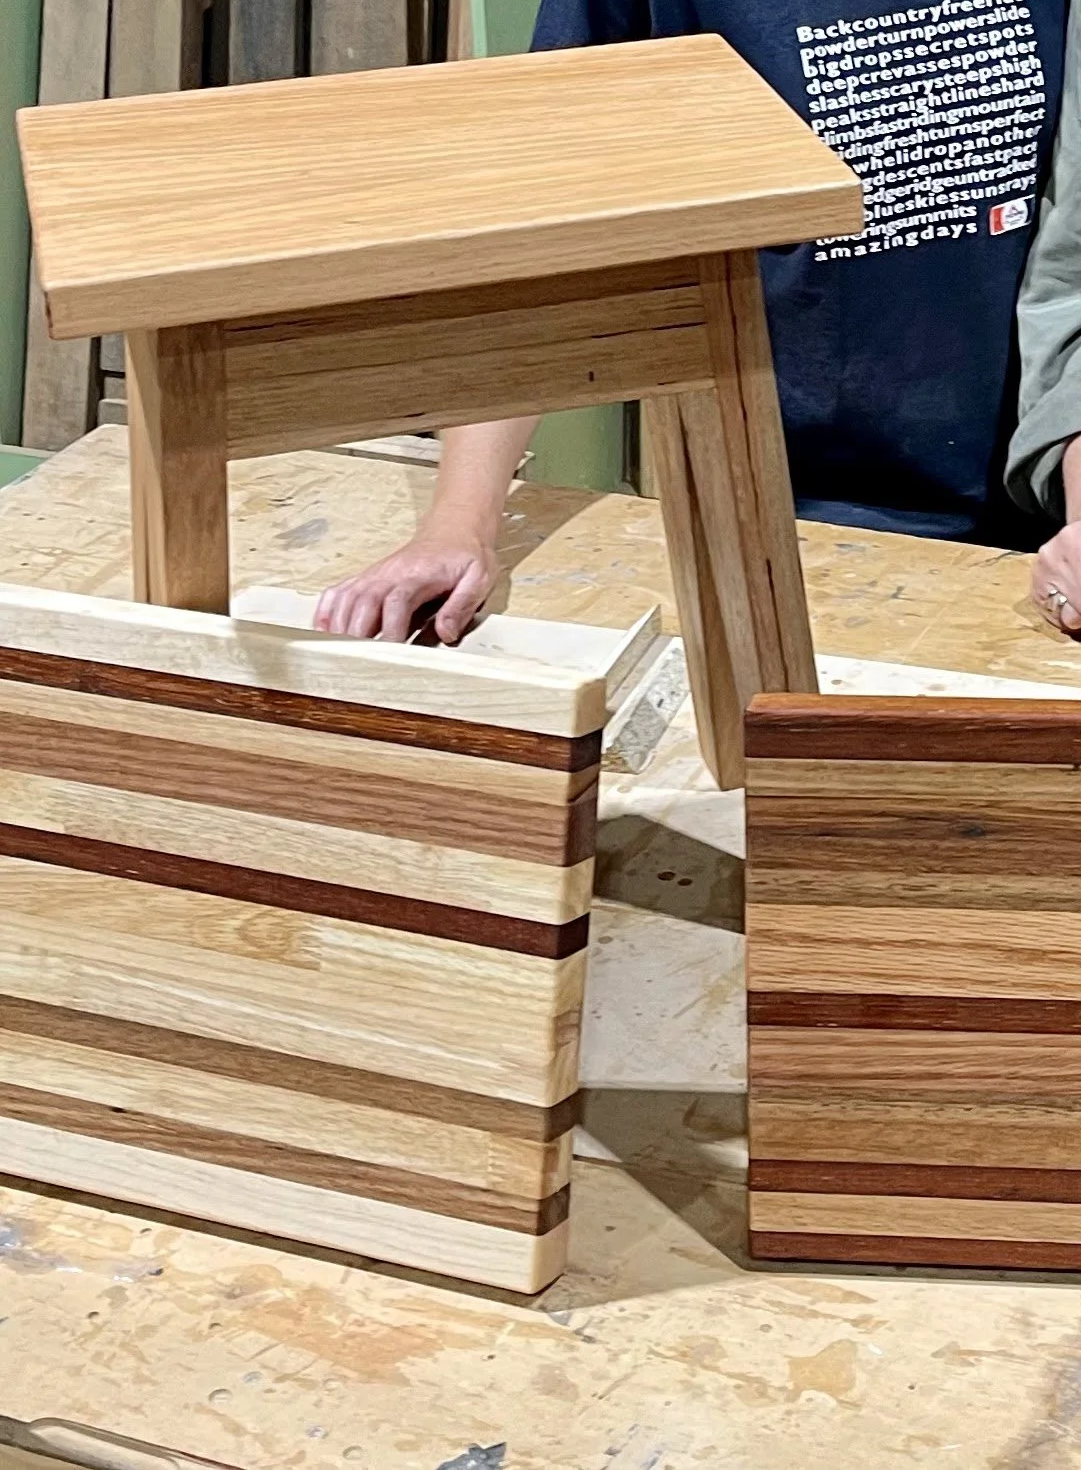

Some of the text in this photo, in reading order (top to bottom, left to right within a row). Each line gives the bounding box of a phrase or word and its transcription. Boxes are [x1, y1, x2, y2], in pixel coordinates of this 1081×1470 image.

[800, 5, 1031, 61] powderturnpowerslide
[801, 23, 1035, 79] bigdropssecretspots
[805, 39, 1038, 97] deepcrevassespowder
[808, 54, 1042, 113] slashesscarysteepshigh
[811, 71, 1045, 135] peaksstraightlineshard
[819, 90, 1046, 146] limbsfastridingmountain
[836, 107, 1046, 161] idingfreshturnsperfect
[814, 221, 978, 262] amazingdays
